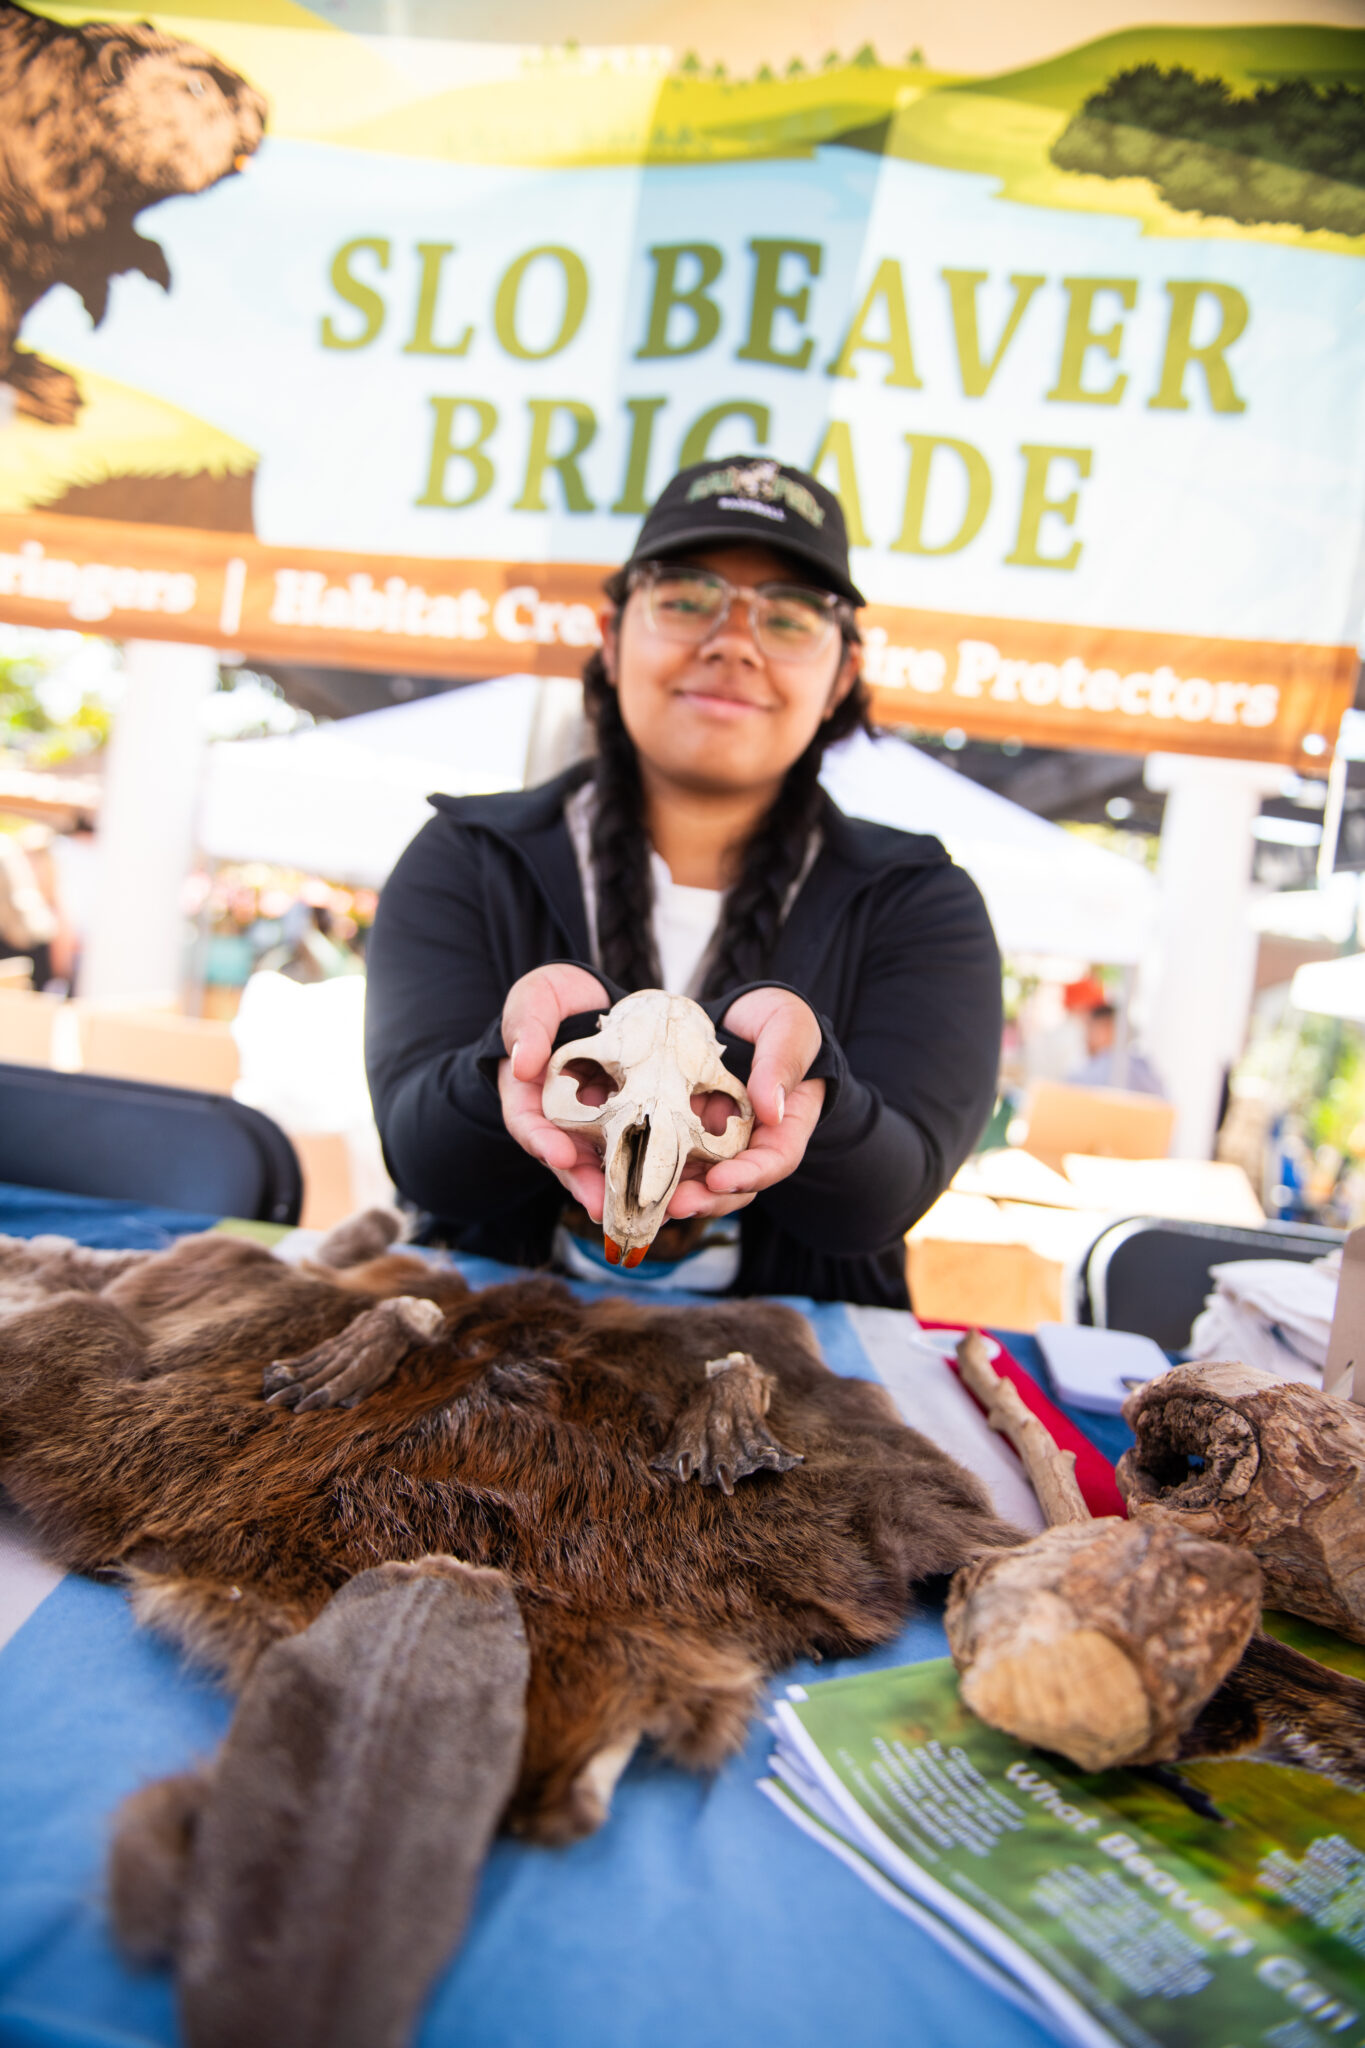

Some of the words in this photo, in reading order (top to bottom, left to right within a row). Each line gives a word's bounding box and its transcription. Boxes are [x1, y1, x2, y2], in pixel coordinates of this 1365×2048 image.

[320, 236, 589, 361] SLO
[635, 237, 1251, 415] BEAVER
[270, 568, 489, 641] Habitat
[493, 585, 603, 647] Cre
[863, 626, 946, 693] ire
[952, 640, 1280, 727] Protectors
[1004, 1760, 1100, 1835] What
